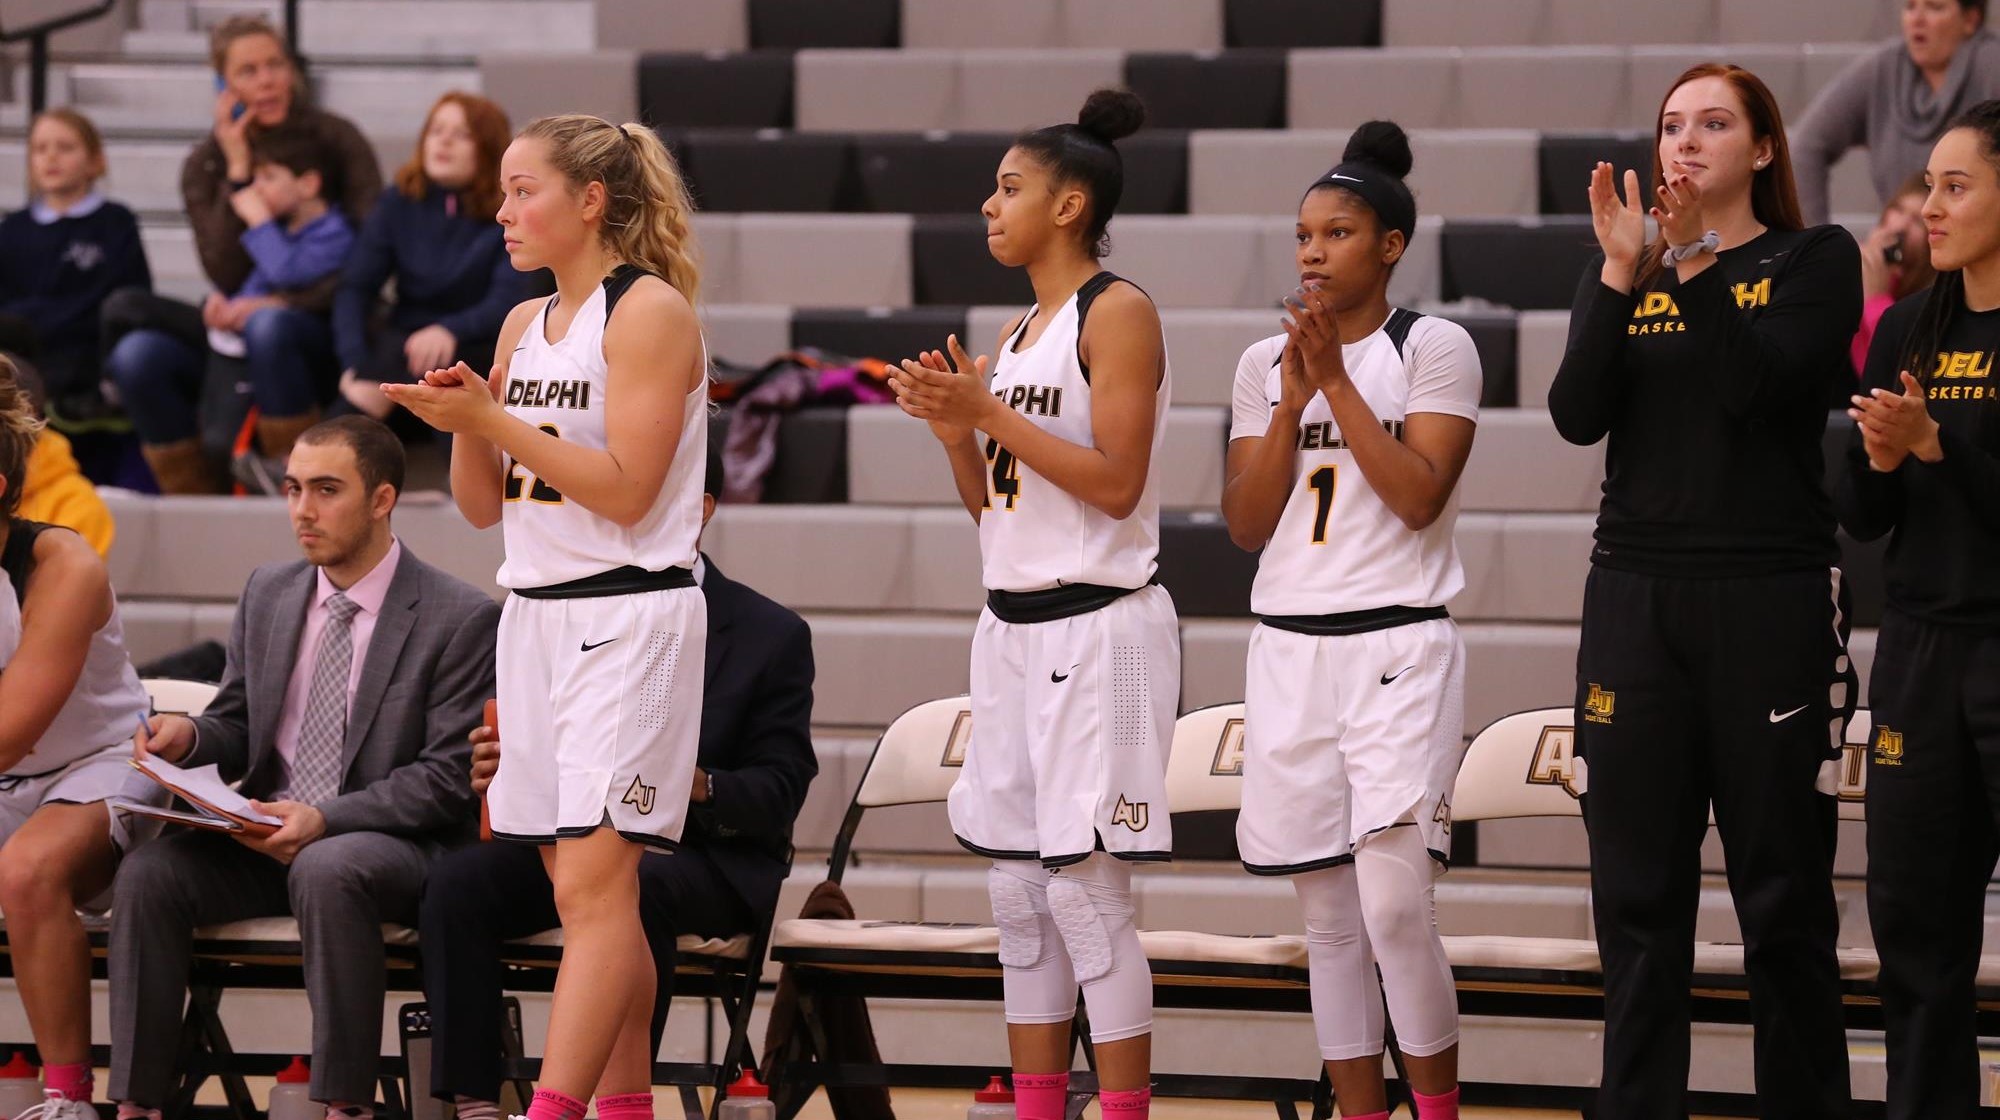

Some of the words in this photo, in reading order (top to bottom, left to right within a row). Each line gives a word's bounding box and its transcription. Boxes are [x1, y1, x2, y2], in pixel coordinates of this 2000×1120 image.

[505, 378, 591, 410] DELPHI
[1307, 464, 1338, 545] 1
[1585, 682, 1615, 717] AU
[1526, 725, 1580, 799] A
[1874, 724, 1904, 760] AU
[621, 773, 656, 815] AU
[1111, 793, 1148, 833] AU
